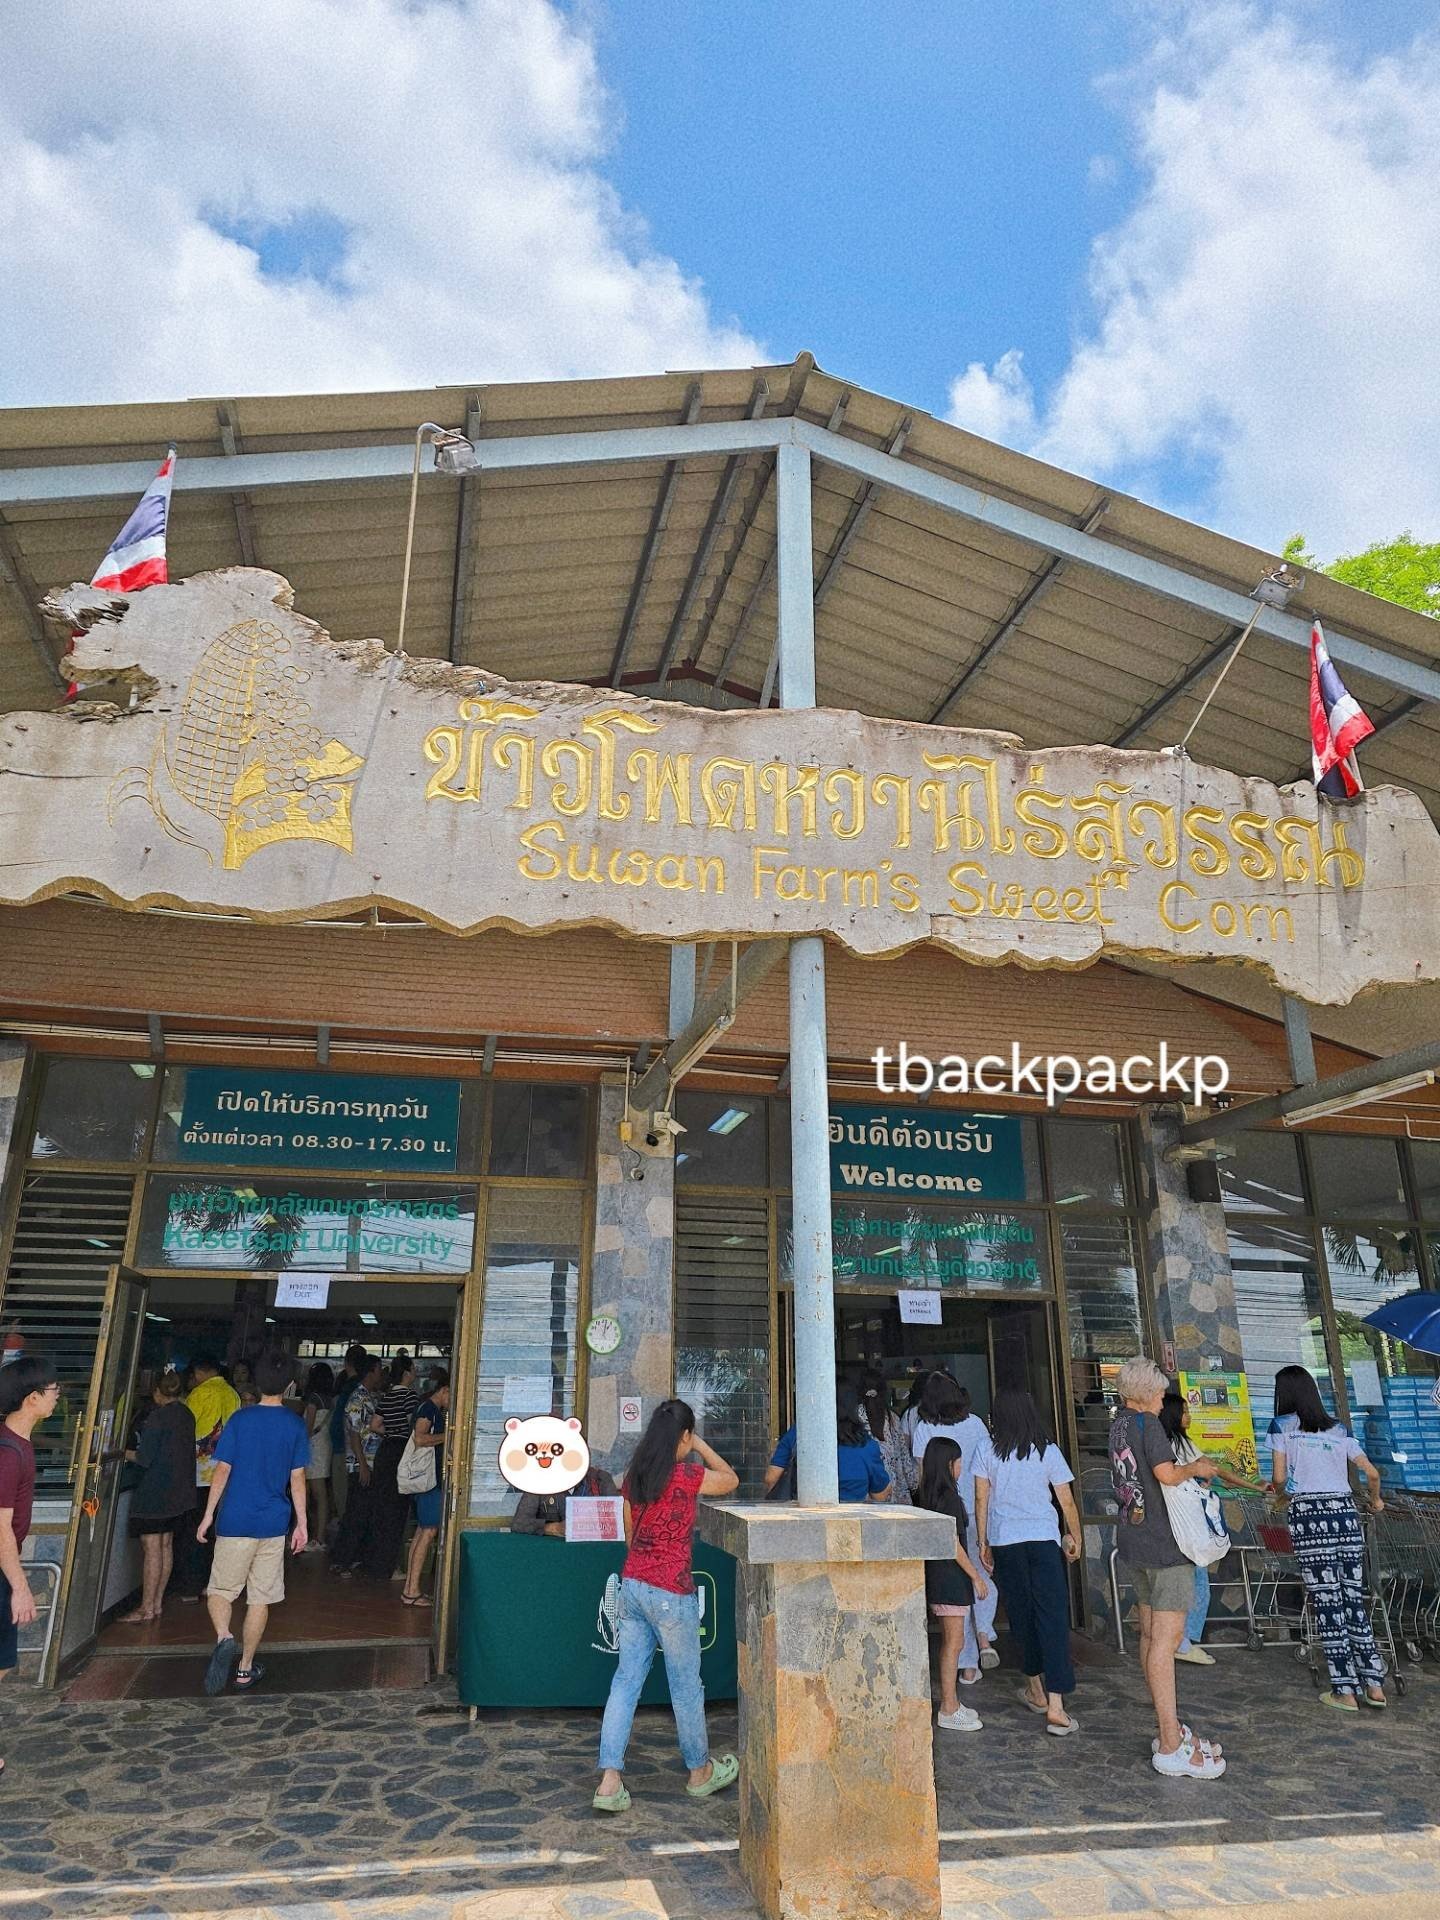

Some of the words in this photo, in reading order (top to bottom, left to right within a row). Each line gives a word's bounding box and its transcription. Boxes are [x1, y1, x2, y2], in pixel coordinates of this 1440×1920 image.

[516, 820, 726, 895] Suwan
[752, 845, 922, 914] Farm's
[947, 861, 1115, 927] Sweet
[1158, 879, 1295, 943] Corn
[217, 1090, 428, 1123] เปิดให้บริการทุกวัน
[183, 1121, 284, 1147] ตั้งแต่เวลา
[292, 1133, 426, 1152] 08.30-17.30
[433, 1139, 452, 1153] น.
[839, 1163, 983, 1193] Welcome
[161, 1222, 312, 1253] Kasetsart
[317, 1227, 455, 1260] University
